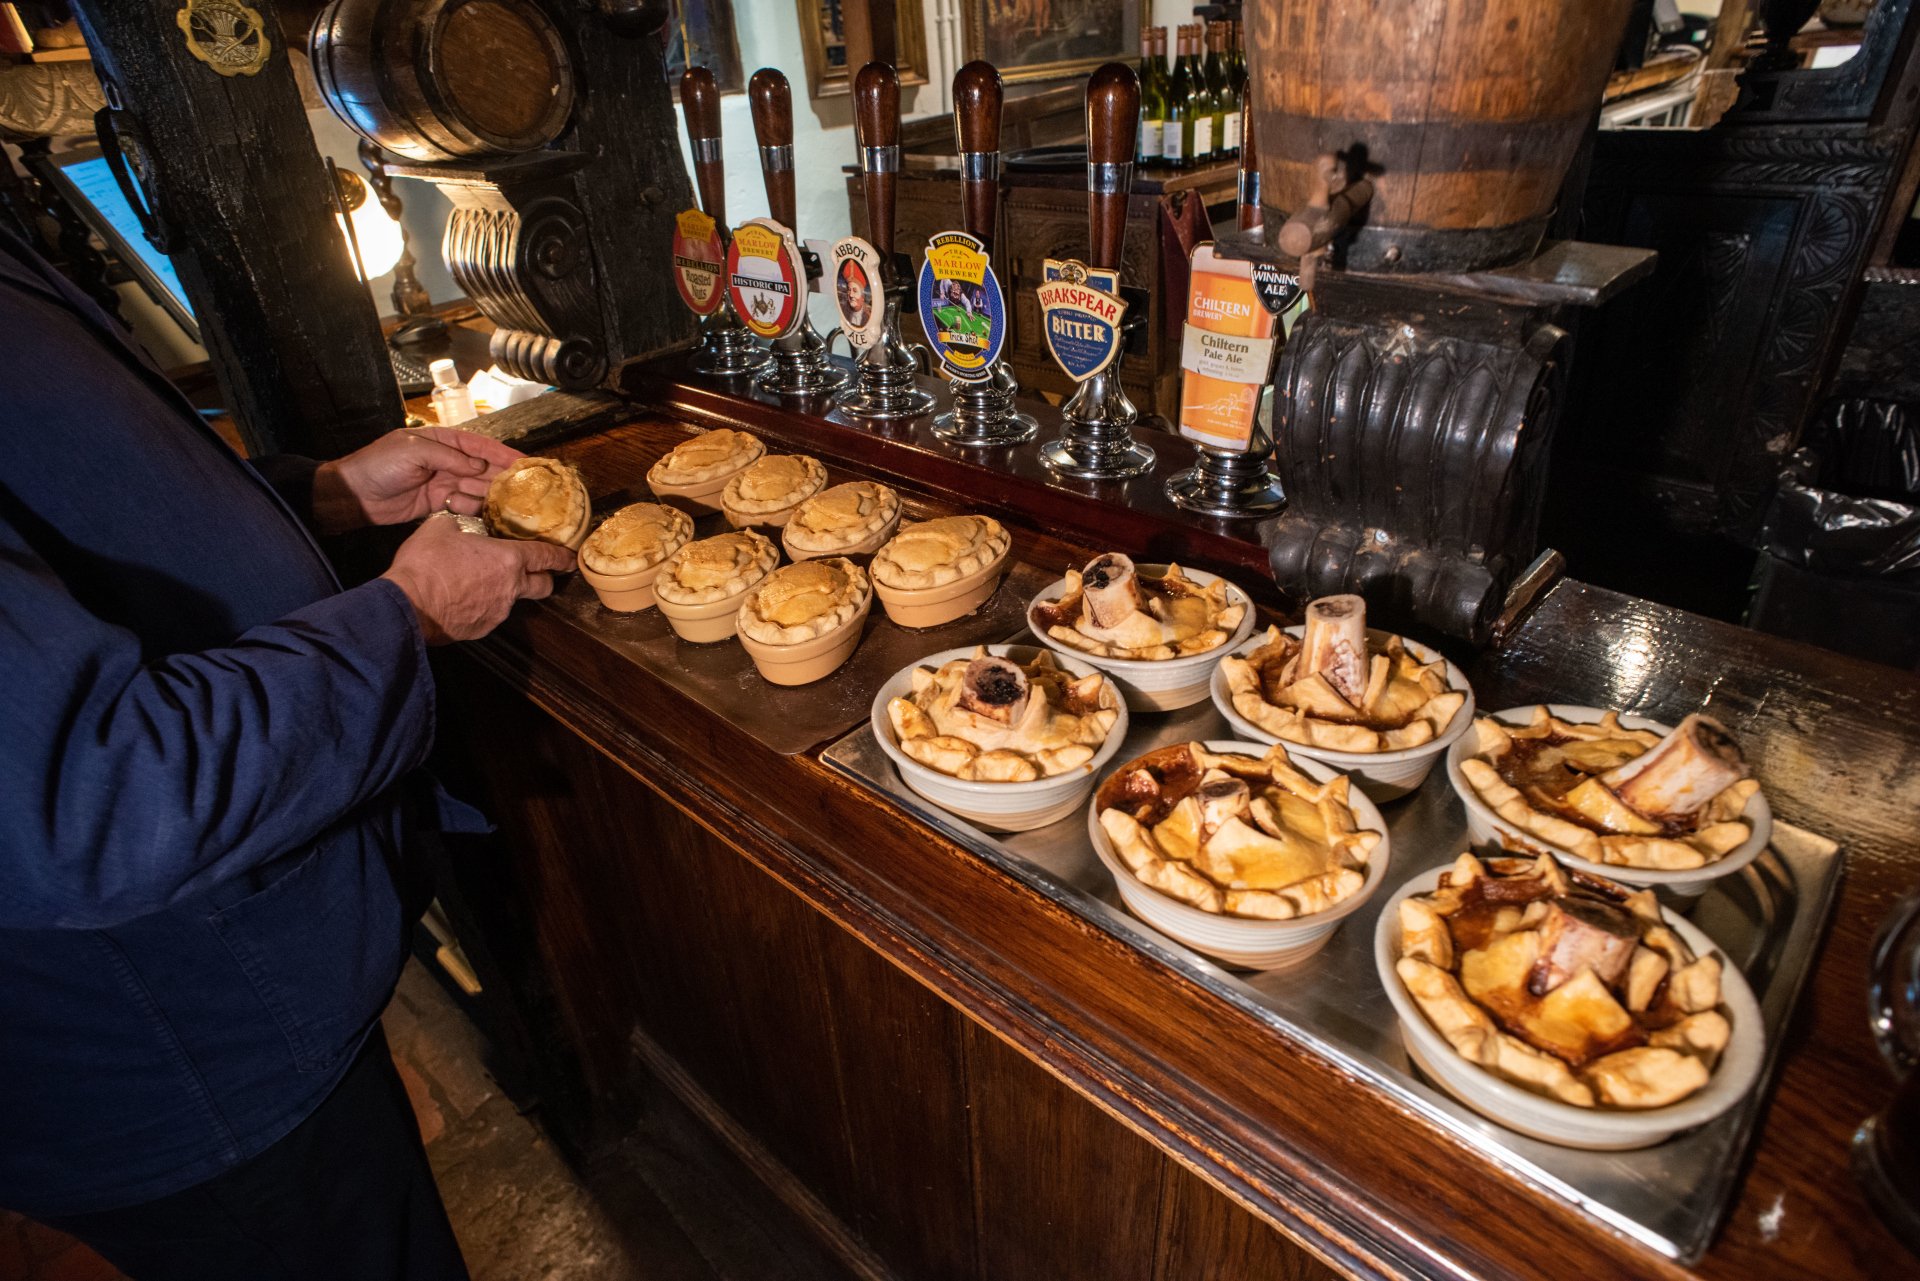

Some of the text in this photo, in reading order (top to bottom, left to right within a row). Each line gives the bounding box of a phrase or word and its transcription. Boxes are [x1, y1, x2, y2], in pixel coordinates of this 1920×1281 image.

[738, 238, 776, 249] MARLOW
[935, 235, 977, 250] REBELLION
[742, 247, 773, 256] BREWERY
[835, 243, 868, 262] ABBOT
[676, 258, 719, 273] REBELLION
[934, 258, 981, 271] MARLOW
[686, 270, 711, 286] Roasted
[939, 268, 978, 278] BREWERY
[1254, 270, 1300, 286] WINNING
[692, 284, 706, 299] Nuts
[733, 277, 788, 293] HISTORIC IPA
[1264, 284, 1285, 296] ALE
[1041, 287, 1117, 321] BRAKSPEAR
[1193, 296, 1251, 317] CHILTERN
[1192, 309, 1223, 321] BREWERY
[1052, 316, 1105, 342] BITTER
[848, 332, 867, 345] ALE
[949, 332, 978, 345] Trick Shot
[1201, 334, 1249, 354] Chiltern
[1204, 348, 1243, 364] Pale Ale
